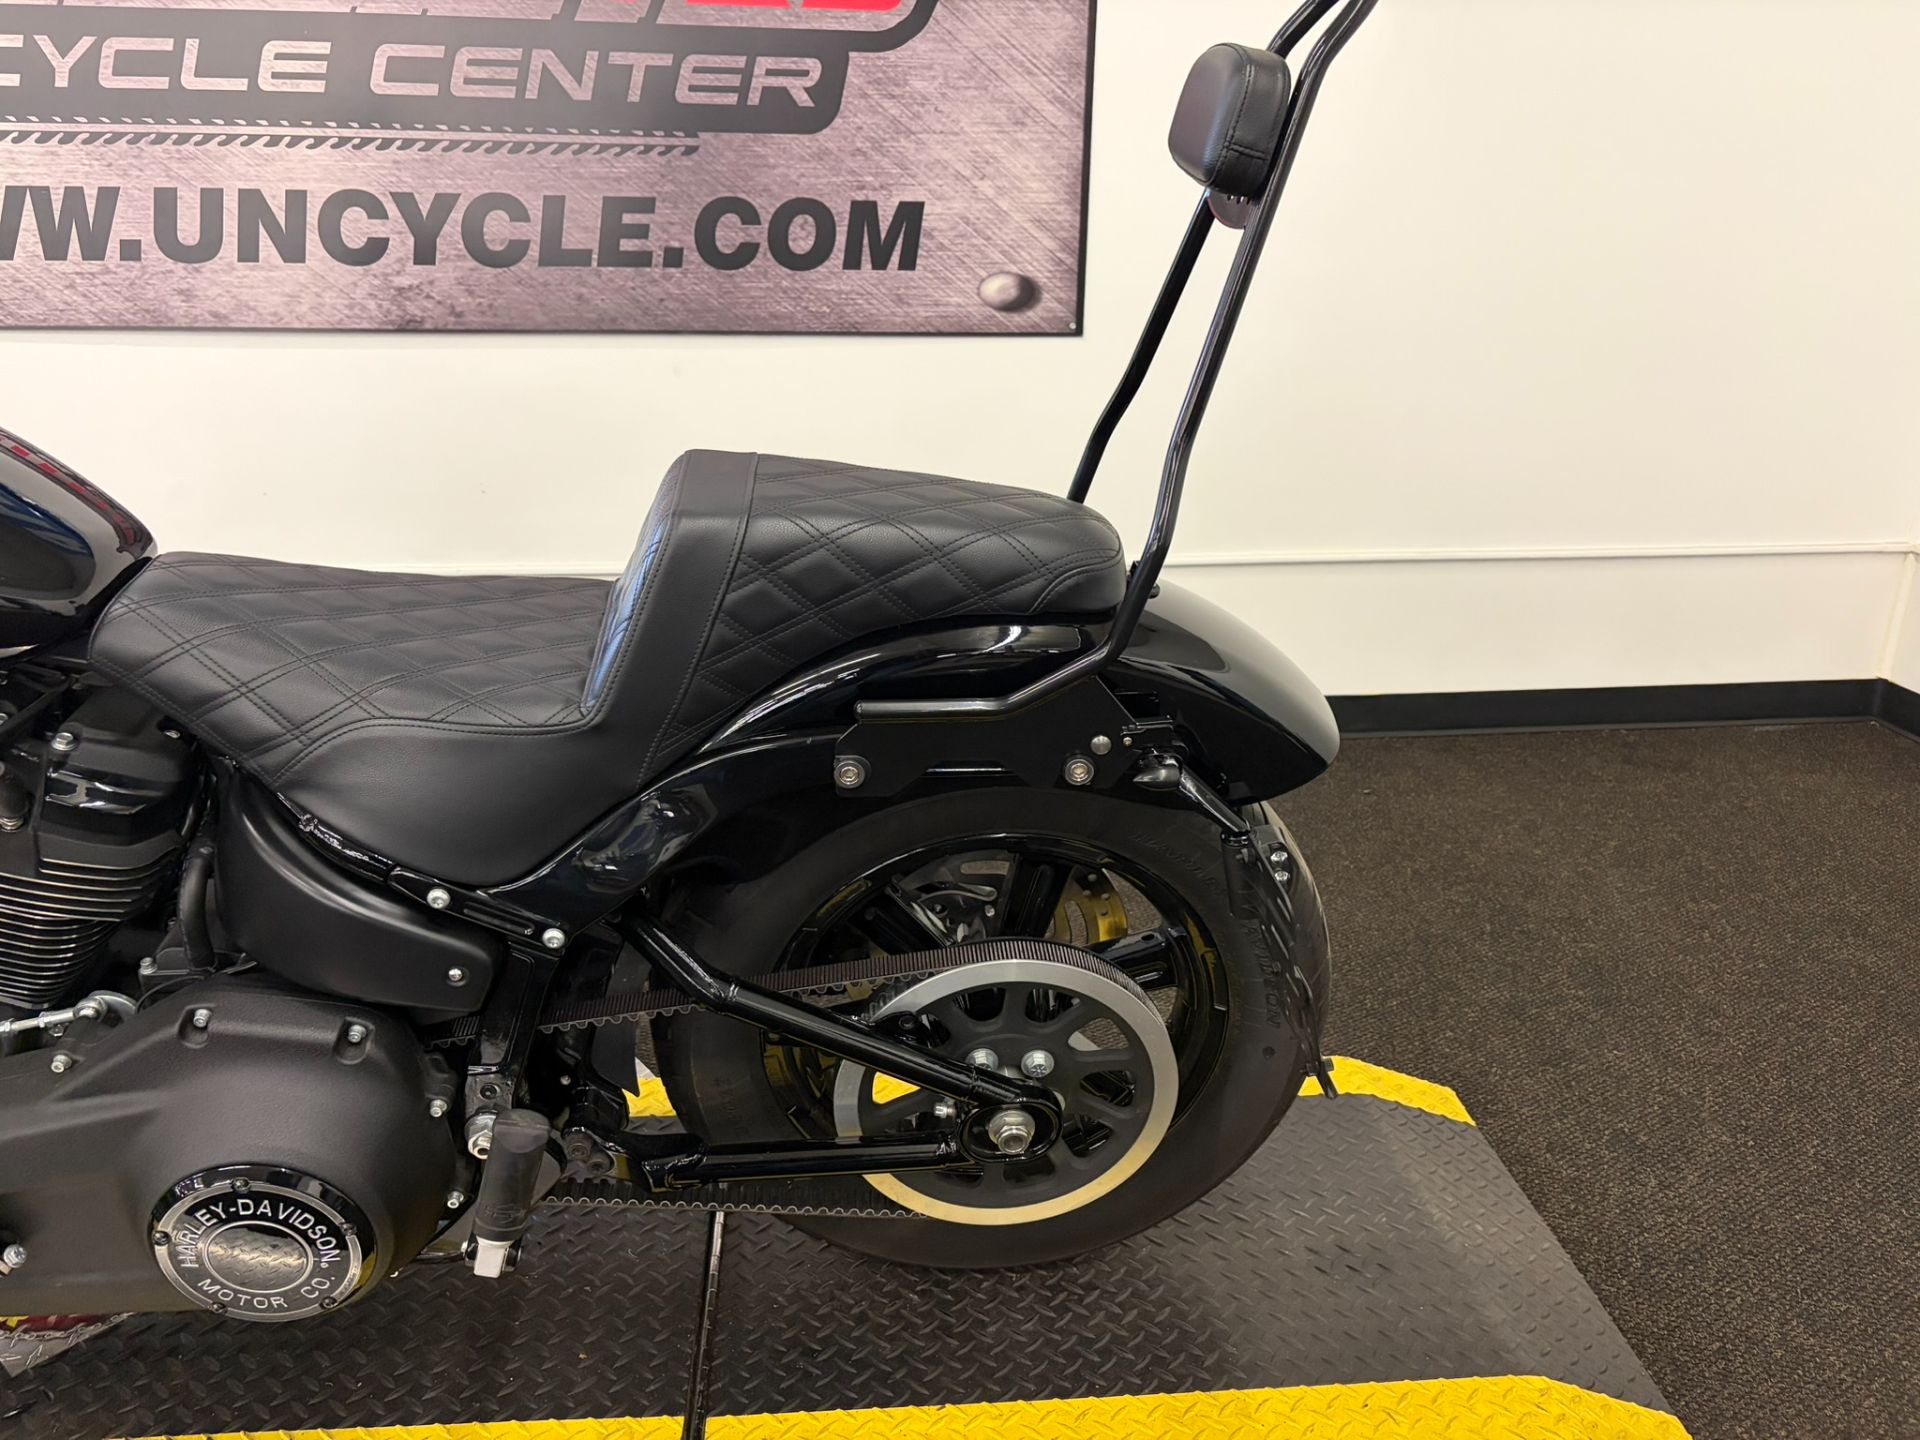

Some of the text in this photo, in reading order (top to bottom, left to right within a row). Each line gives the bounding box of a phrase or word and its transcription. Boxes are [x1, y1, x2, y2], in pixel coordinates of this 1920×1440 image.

[370, 43, 823, 107] CENTER
[197, 1277, 335, 1309] MOTOR CO.
